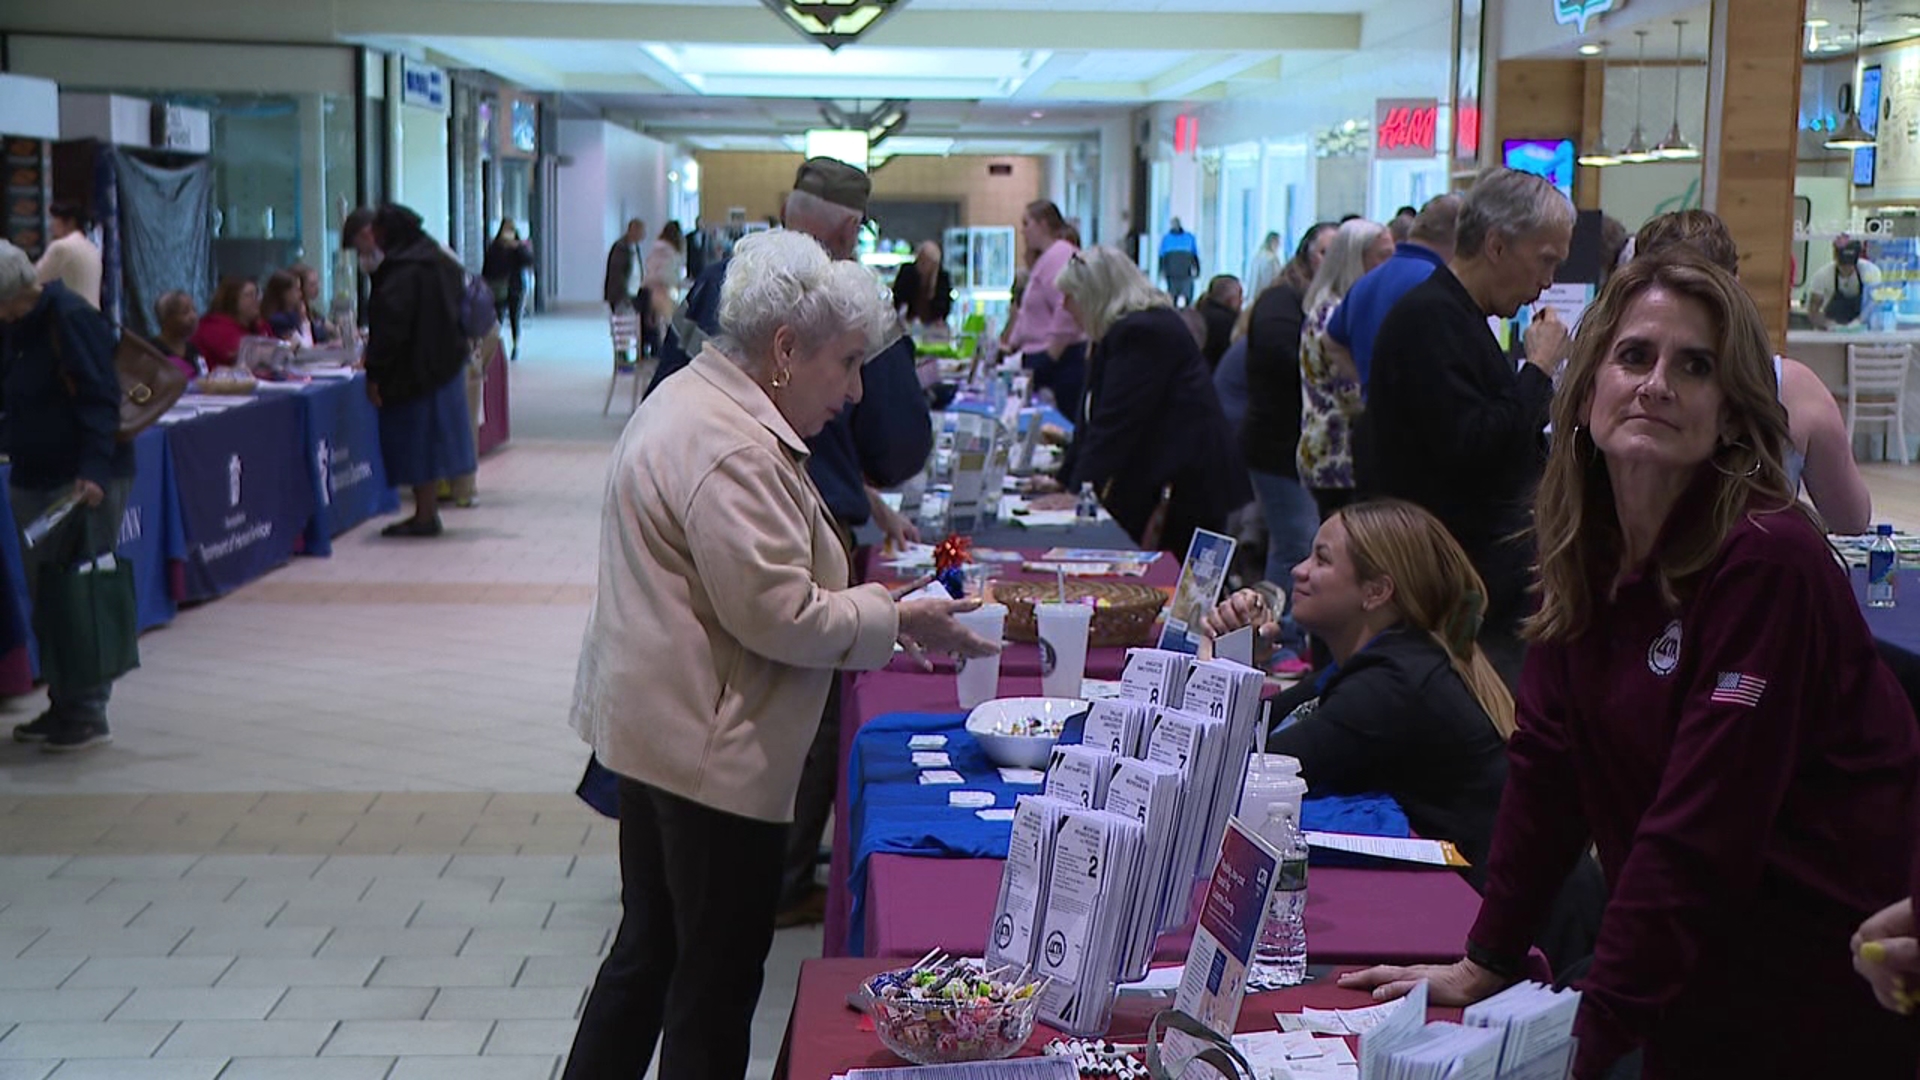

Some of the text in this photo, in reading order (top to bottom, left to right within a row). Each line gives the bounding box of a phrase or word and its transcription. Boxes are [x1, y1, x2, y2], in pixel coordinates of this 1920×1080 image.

[1378, 107, 1437, 151] H&M
[1149, 688, 1159, 705] 8
[1209, 701, 1223, 720] 10
[1111, 737, 1120, 754] 6
[1178, 754, 1187, 769] 7
[1080, 790, 1089, 808] 3
[1137, 805, 1146, 824] 5
[1033, 840, 1039, 862] 1
[1088, 855, 1099, 879] 2
